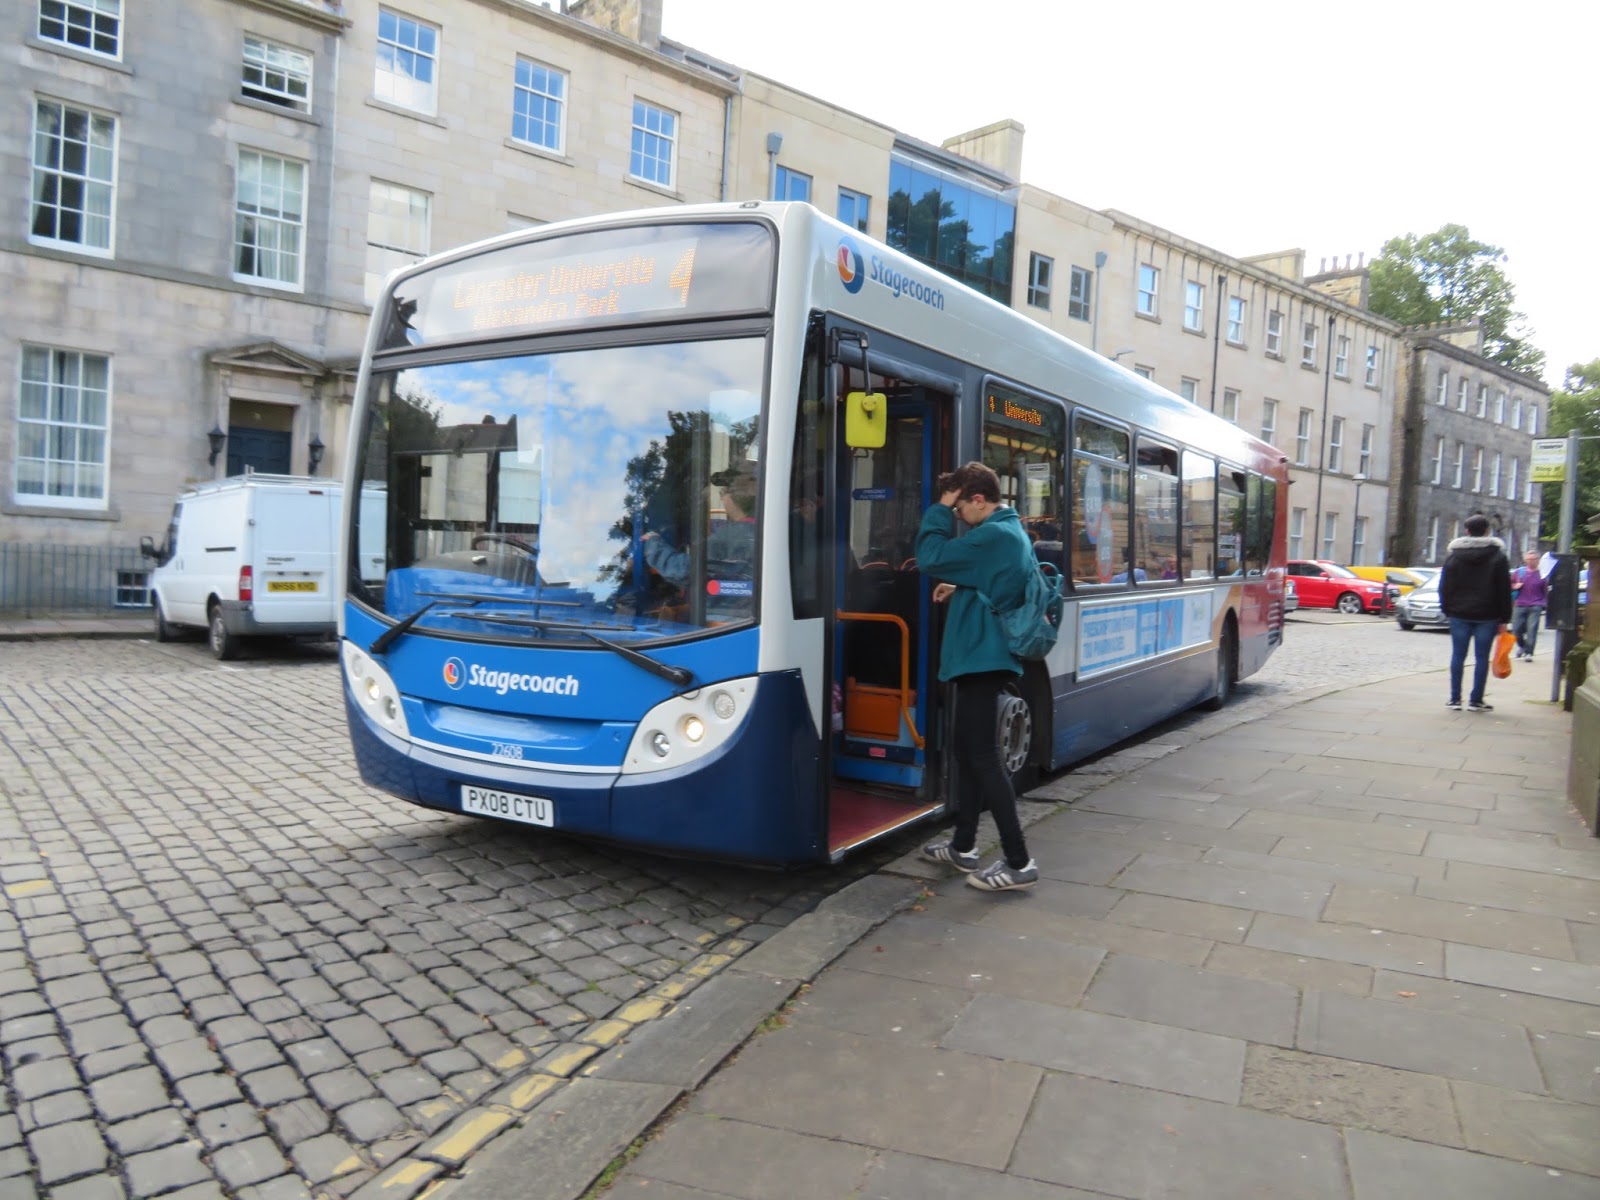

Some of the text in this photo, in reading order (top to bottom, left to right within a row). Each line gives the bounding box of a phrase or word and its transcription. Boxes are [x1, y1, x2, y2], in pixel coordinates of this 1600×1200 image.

[453, 253, 656, 310] Lancaster University
[669, 247, 695, 302] 4
[870, 255, 945, 311] Stagecoach
[575, 290, 622, 317] Park
[1004, 400, 1042, 426] University
[468, 664, 580, 696] Stagecoach
[491, 741, 524, 760] 22608
[468, 788, 546, 821] PX08 CTU
